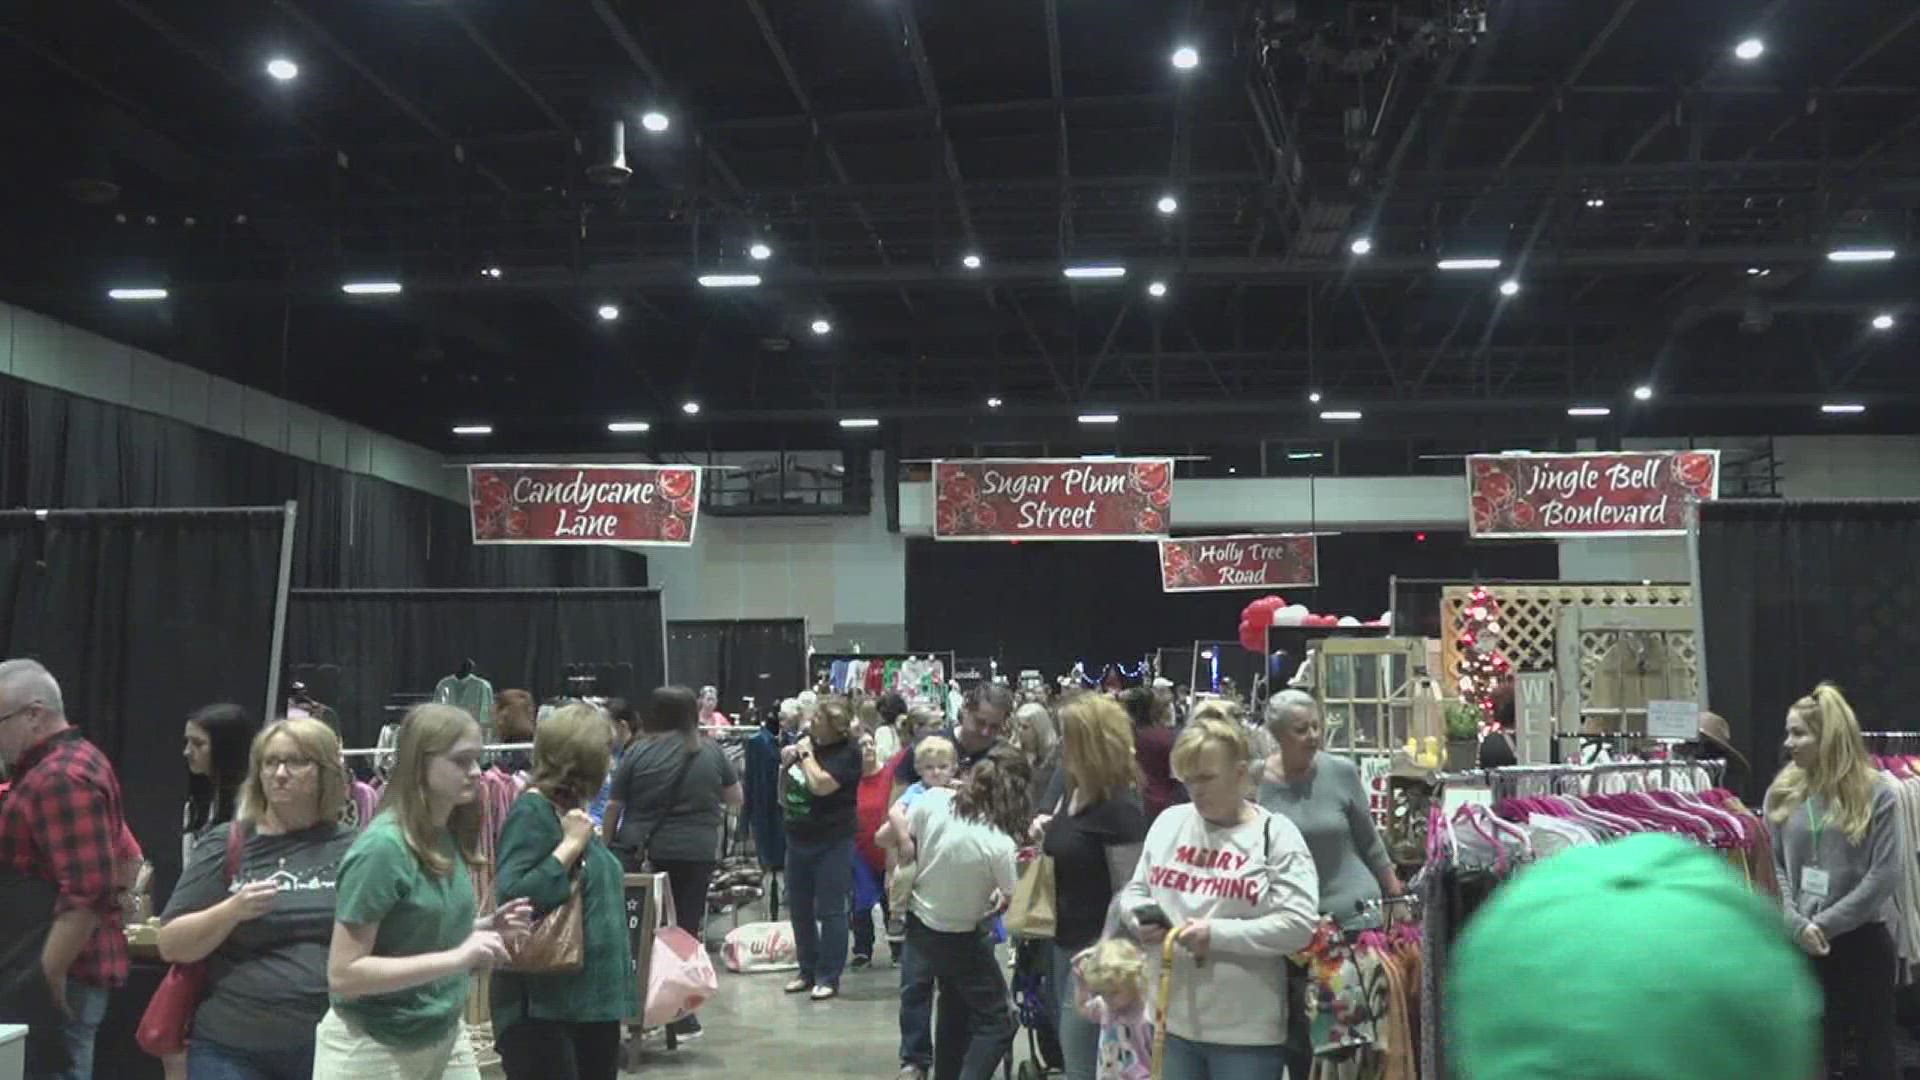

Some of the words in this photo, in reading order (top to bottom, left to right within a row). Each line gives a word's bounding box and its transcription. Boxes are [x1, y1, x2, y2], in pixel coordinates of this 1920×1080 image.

[513, 471, 655, 513] Candycane
[981, 470, 1054, 503] Sugar
[1060, 465, 1126, 496] Plum
[1526, 459, 1599, 498] Jingle
[1605, 459, 1661, 491] Bell
[555, 509, 619, 537] Lane
[1017, 500, 1096, 529] Street
[1539, 495, 1668, 527] Boulevard
[1199, 542, 1244, 565] Holly
[1247, 543, 1284, 561] Tree
[1218, 562, 1268, 585] Road
[1175, 846, 1250, 871] MERRY
